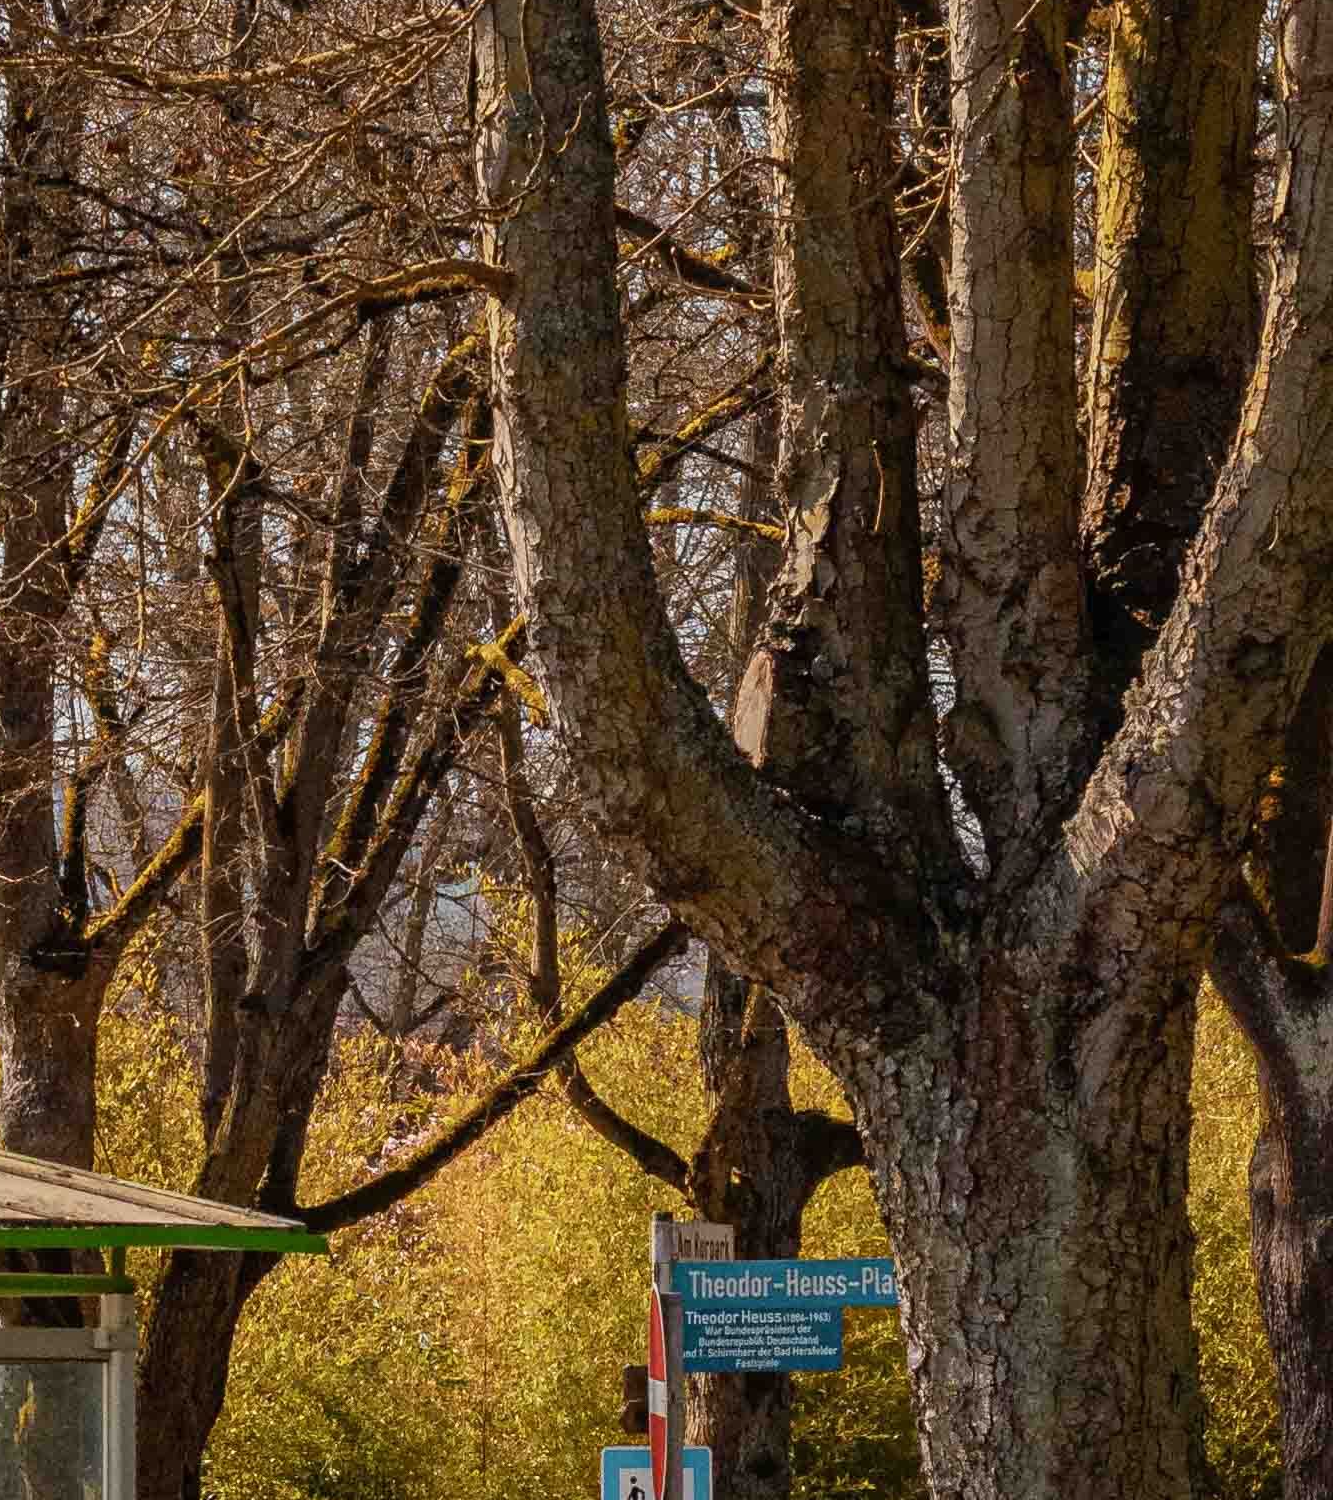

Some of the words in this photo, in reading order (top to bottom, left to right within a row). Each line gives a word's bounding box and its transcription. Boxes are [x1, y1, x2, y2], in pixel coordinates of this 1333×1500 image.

[685, 1310, 740, 1325] Theodor
[741, 1309, 782, 1324] Heuss
[724, 1324, 796, 1336] Bundespräsident
[797, 1323, 813, 1333] der
[698, 1336, 764, 1348] Bundesrepublik
[767, 1335, 820, 1346] Deutschland
[708, 1347, 756, 1358] Schirmherr
[757, 1346, 772, 1357] der
[774, 1346, 790, 1356] Bad
[792, 1345, 838, 1357] Hersfelder
